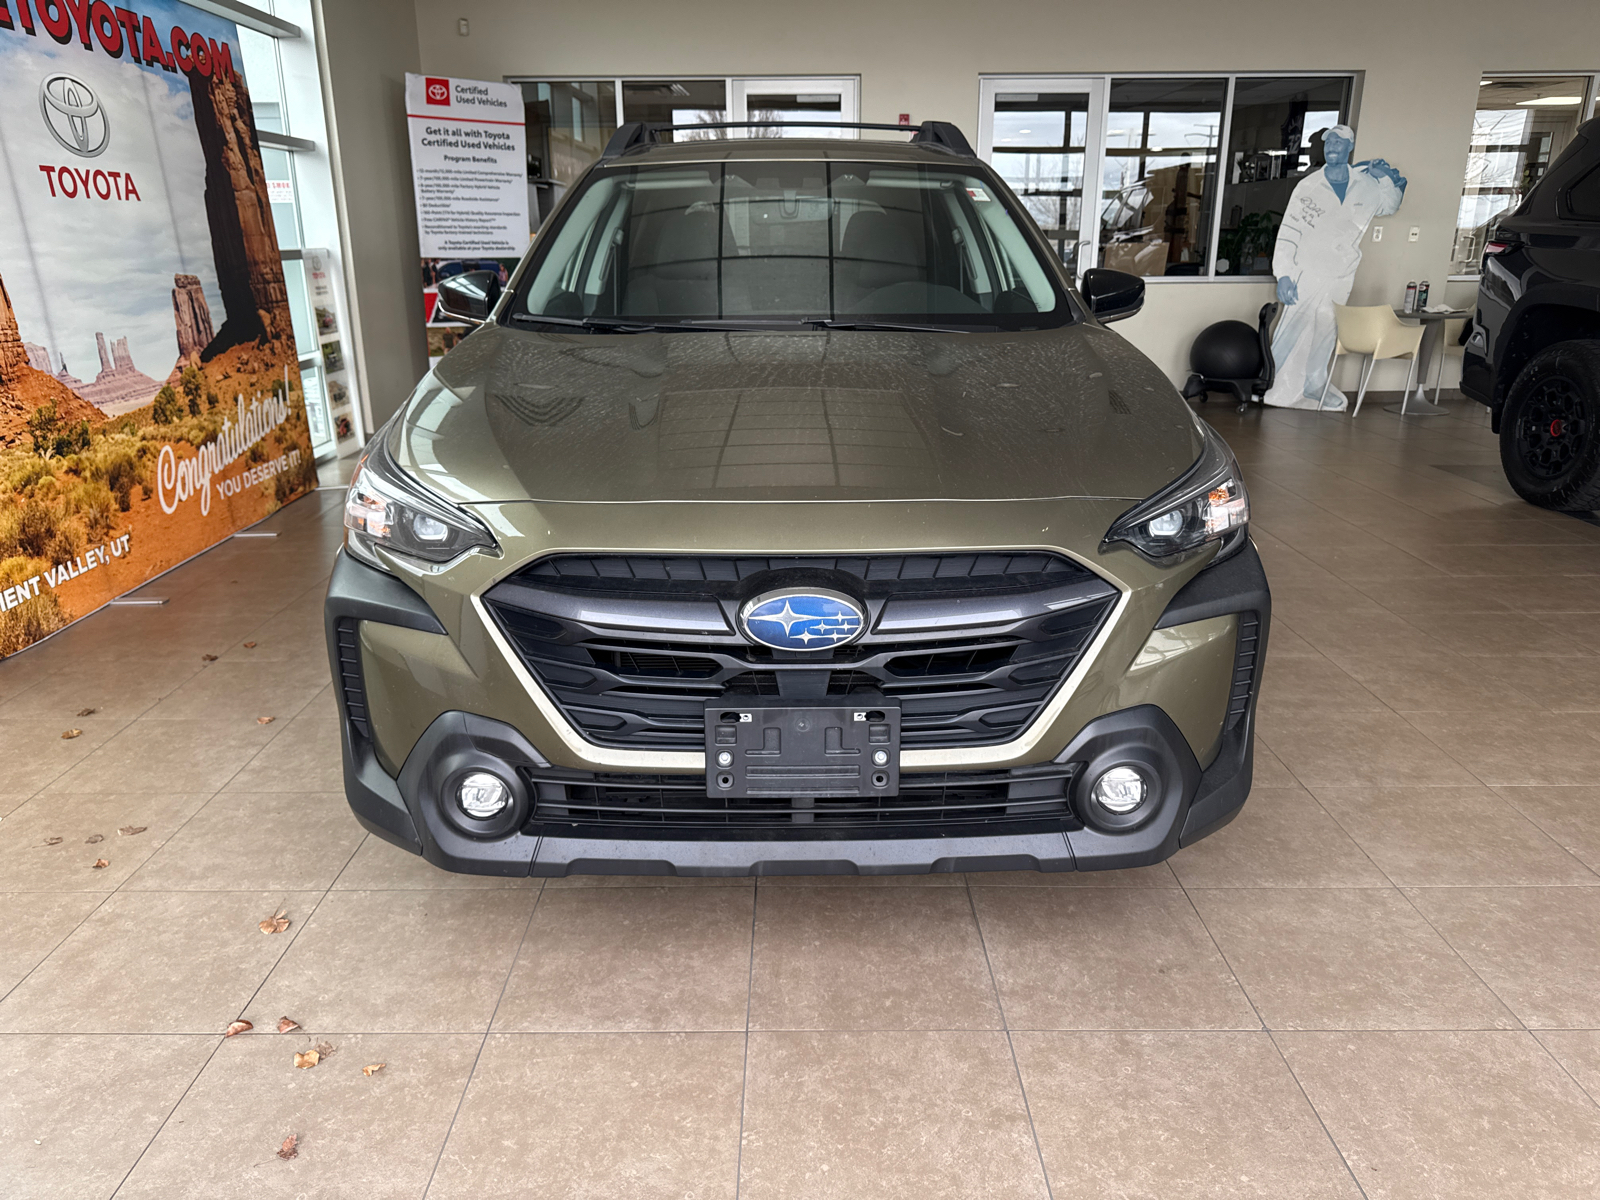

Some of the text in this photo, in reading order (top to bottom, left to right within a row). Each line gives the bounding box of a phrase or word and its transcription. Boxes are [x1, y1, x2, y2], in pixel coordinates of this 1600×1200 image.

[455, 85, 488, 96] Certified
[455, 95, 507, 108] Used Vehicles
[425, 126, 510, 141] Get it all with Toyota
[421, 138, 515, 152] Certified Used Vehicles
[444, 155, 497, 164] Program Benefits
[38, 164, 142, 202] TOYOTA
[157, 364, 292, 517] Congratulations!
[216, 449, 302, 500] YOU DESERVE IT!
[43, 545, 110, 589] VALLEY,
[110, 533, 130, 558] UT
